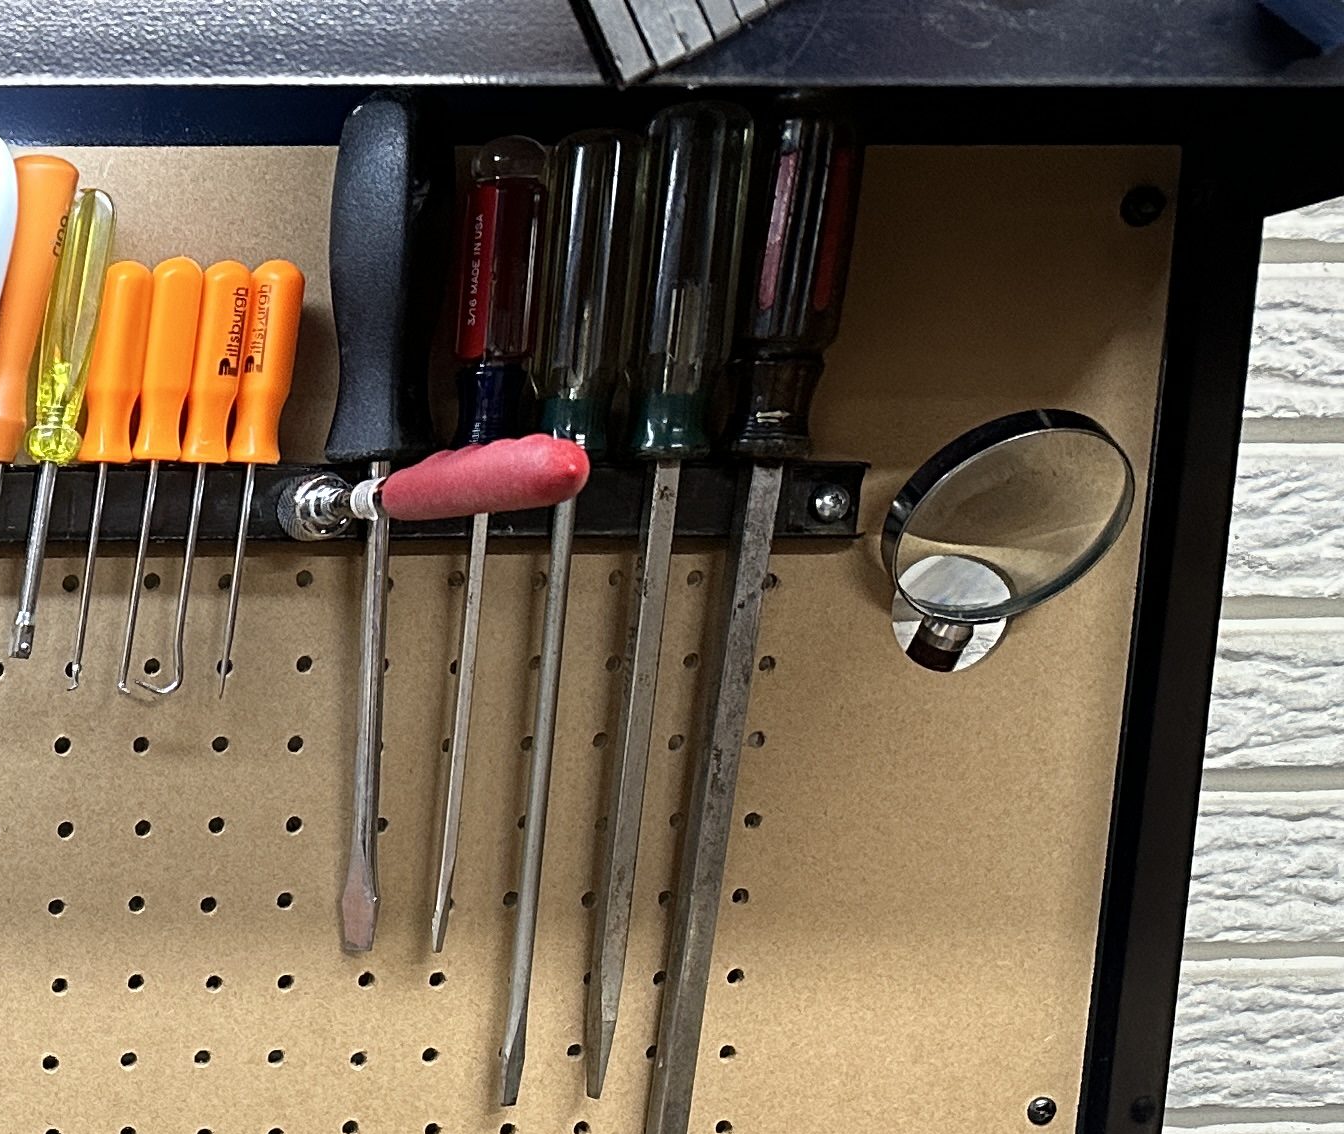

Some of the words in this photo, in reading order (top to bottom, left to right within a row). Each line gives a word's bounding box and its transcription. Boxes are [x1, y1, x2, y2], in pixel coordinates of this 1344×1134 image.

[474, 213, 484, 240] USA
[473, 242, 482, 256] IN
[470, 259, 480, 294] MADE
